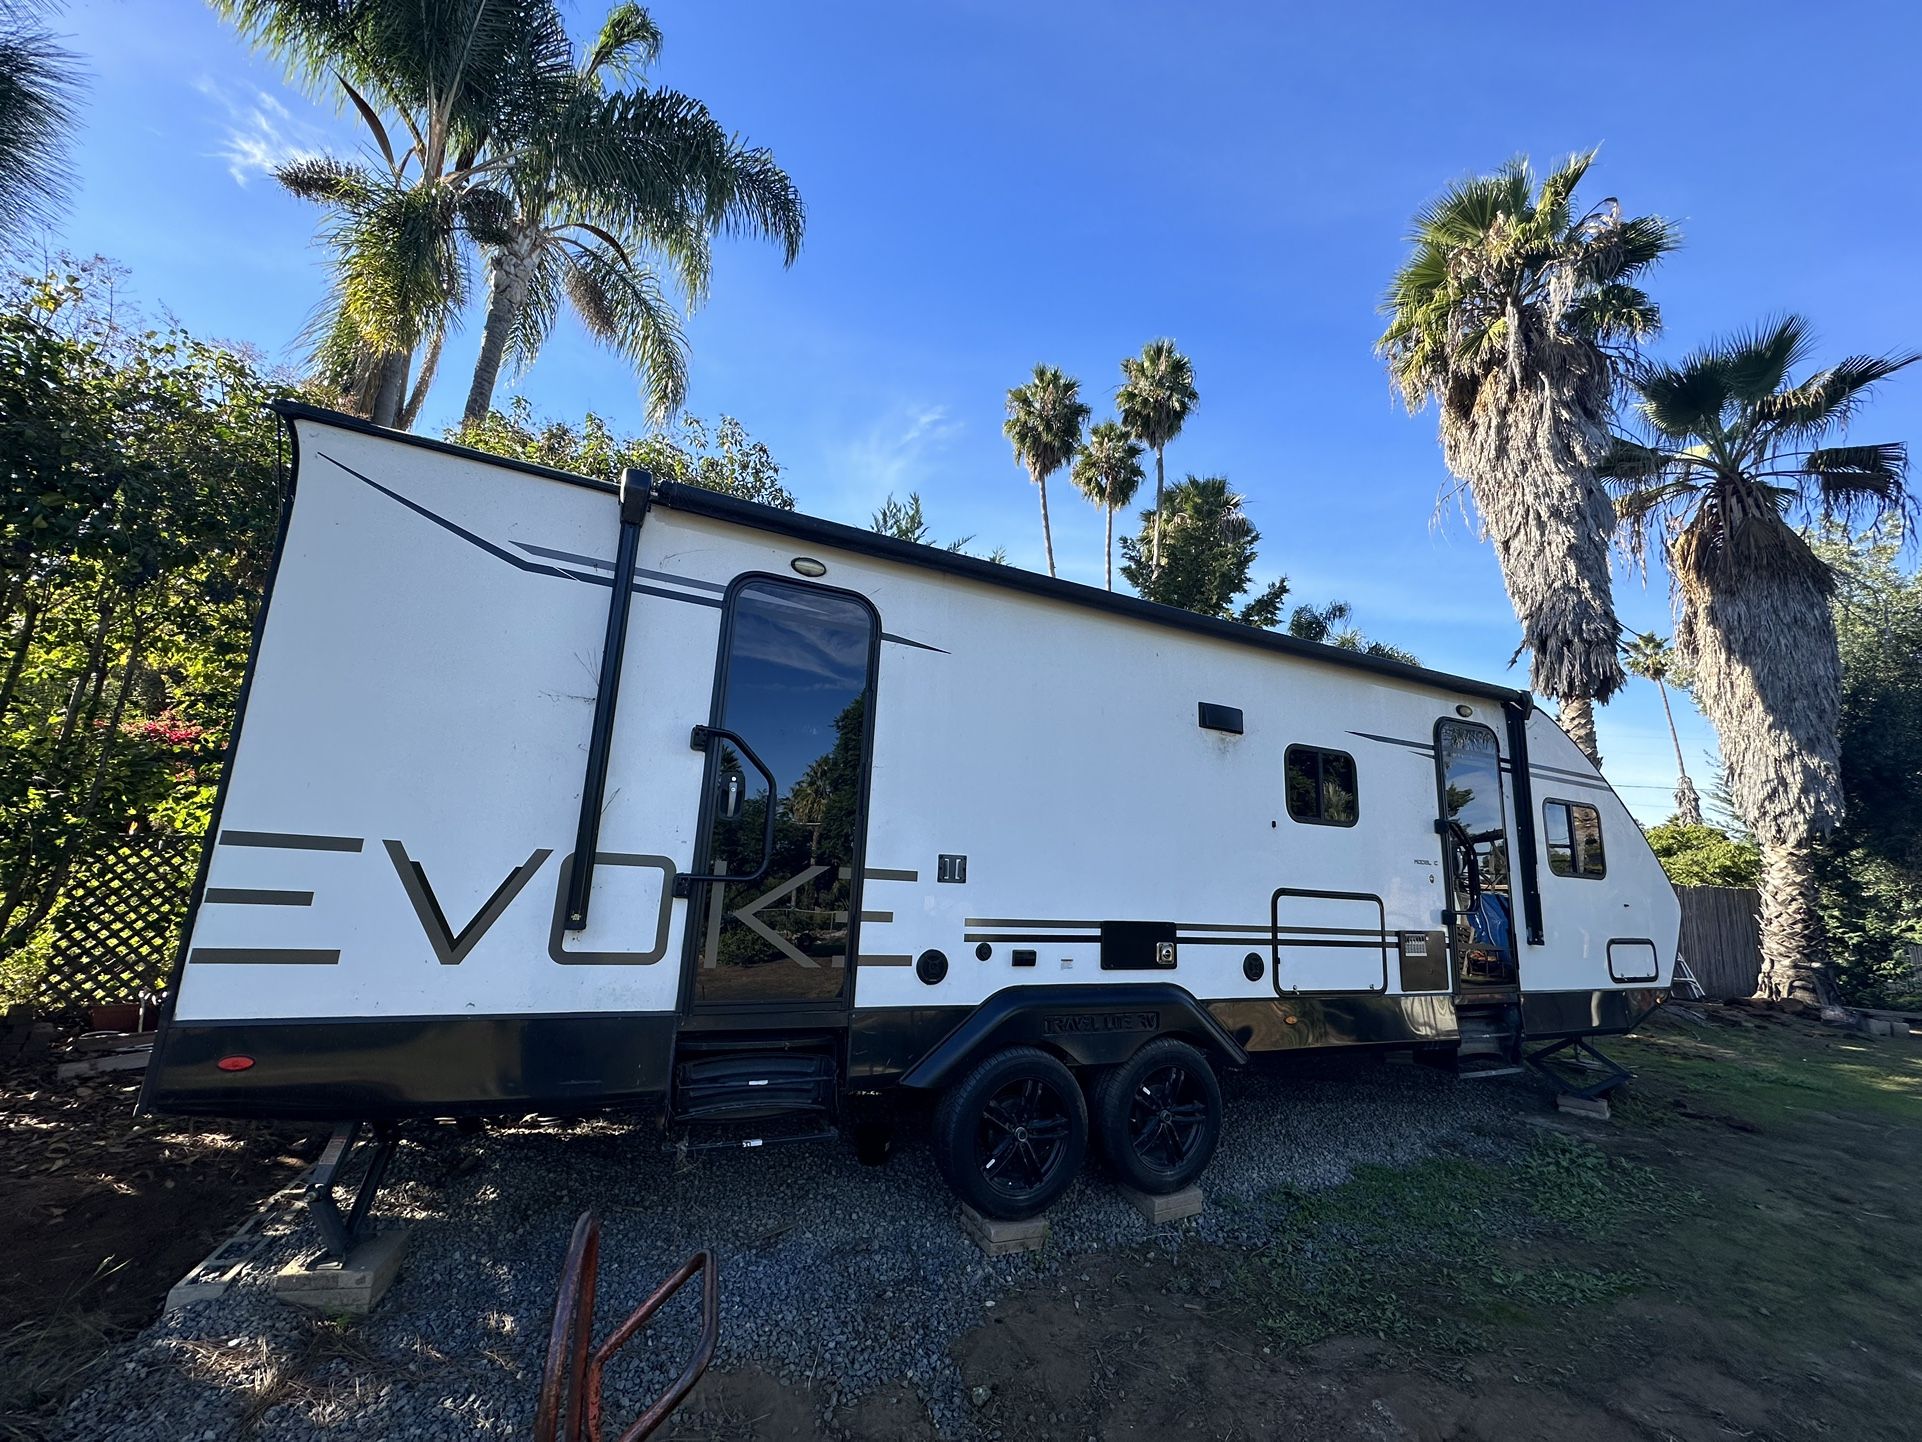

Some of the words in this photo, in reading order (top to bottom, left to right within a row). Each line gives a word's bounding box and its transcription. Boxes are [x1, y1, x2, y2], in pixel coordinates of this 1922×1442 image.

[189, 830, 919, 969] EVOKE
[1042, 1015, 1098, 1034] TRAVEL
[1103, 1014, 1135, 1031] LITE
[1138, 1013, 1157, 1031] RV
